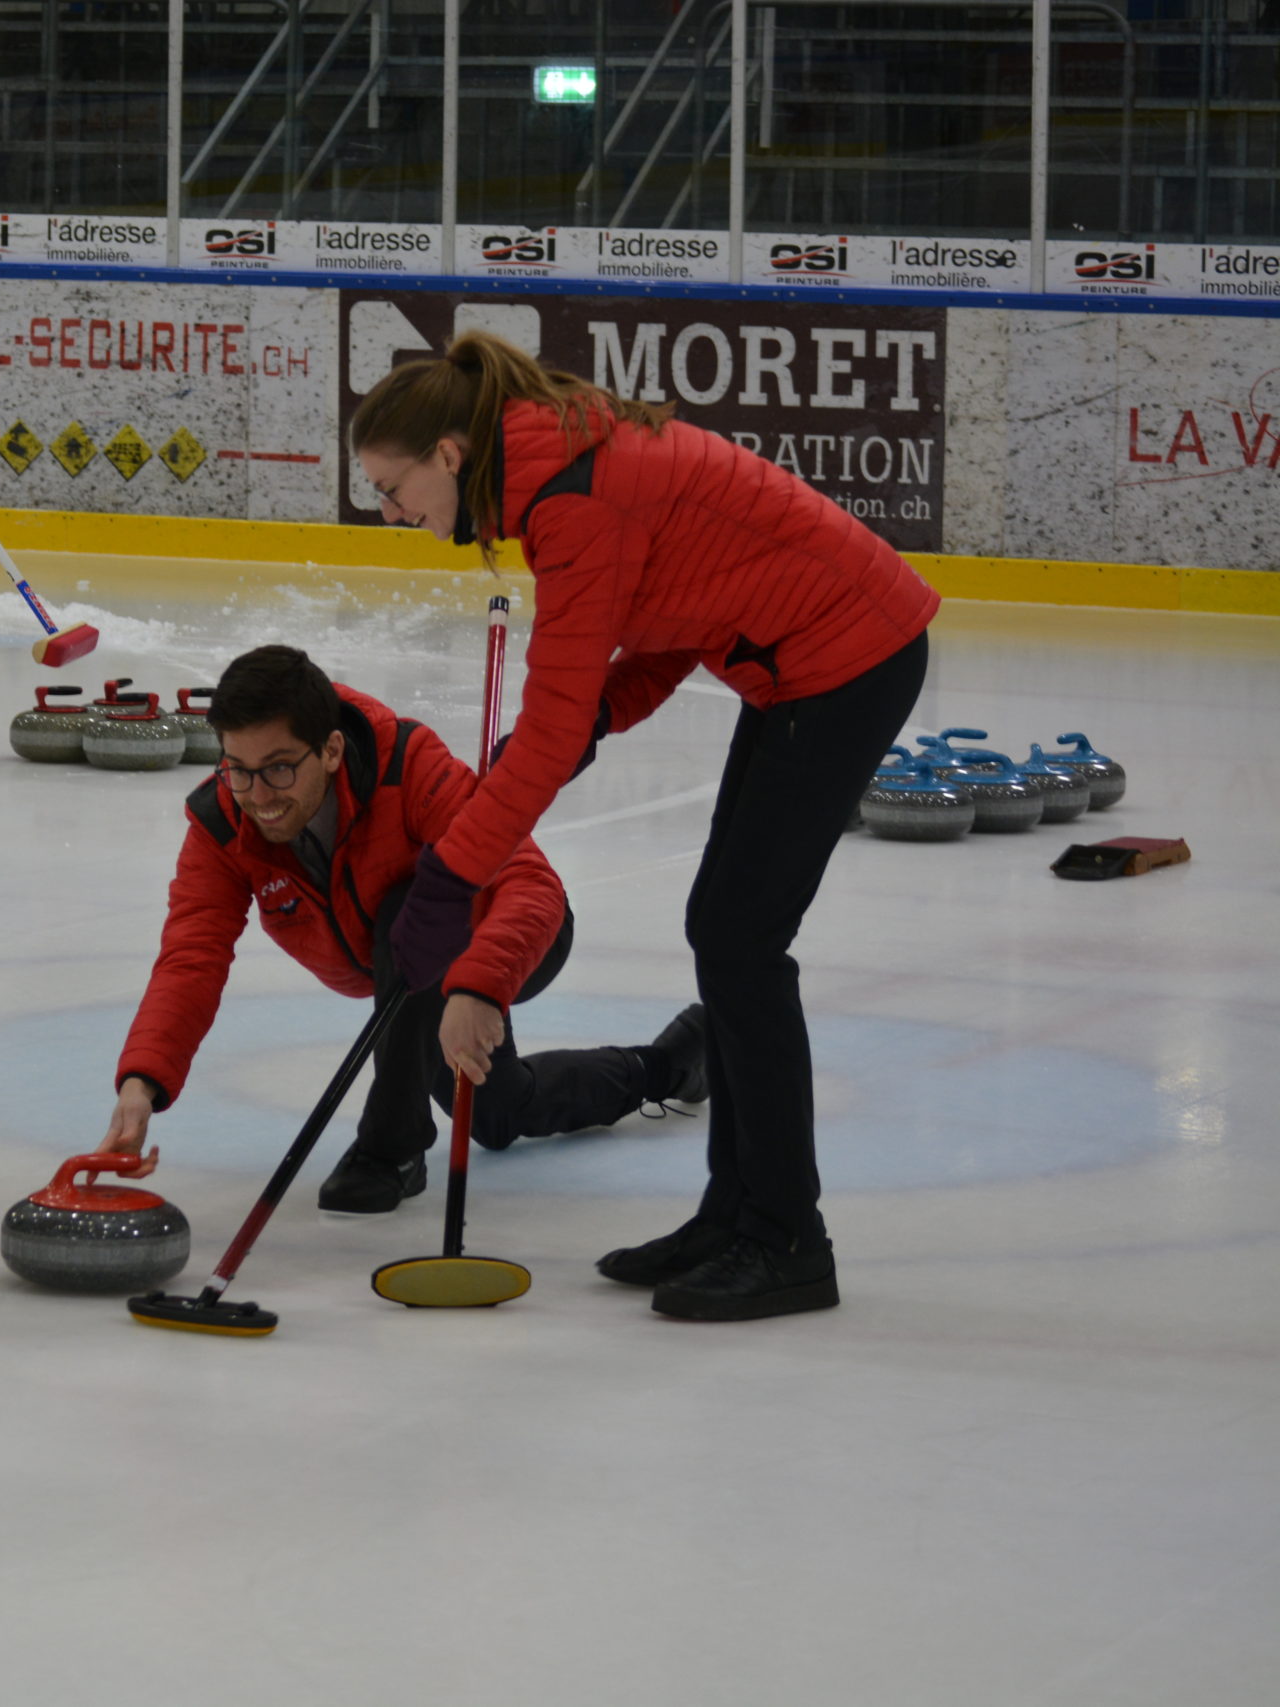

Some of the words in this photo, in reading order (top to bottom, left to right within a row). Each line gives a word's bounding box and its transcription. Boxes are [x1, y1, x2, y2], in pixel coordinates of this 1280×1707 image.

[47, 218, 156, 244] l'adresse
[316, 225, 431, 251] l'adresse
[598, 231, 719, 259] l'adresse
[47, 247, 133, 262] immobilière.
[316, 254, 407, 271] immobilière.
[891, 240, 1017, 269] l'adresse
[210, 260, 269, 269] PEINTURE
[488, 267, 549, 276] PEINTURE
[598, 261, 693, 278] immobilière.
[776, 277, 840, 286] PEINTURE
[891, 271, 991, 288] immobilière.
[1081, 285, 1147, 295] PEINTURE
[588, 321, 936, 411] MORET
[1129, 408, 1208, 466] LA
